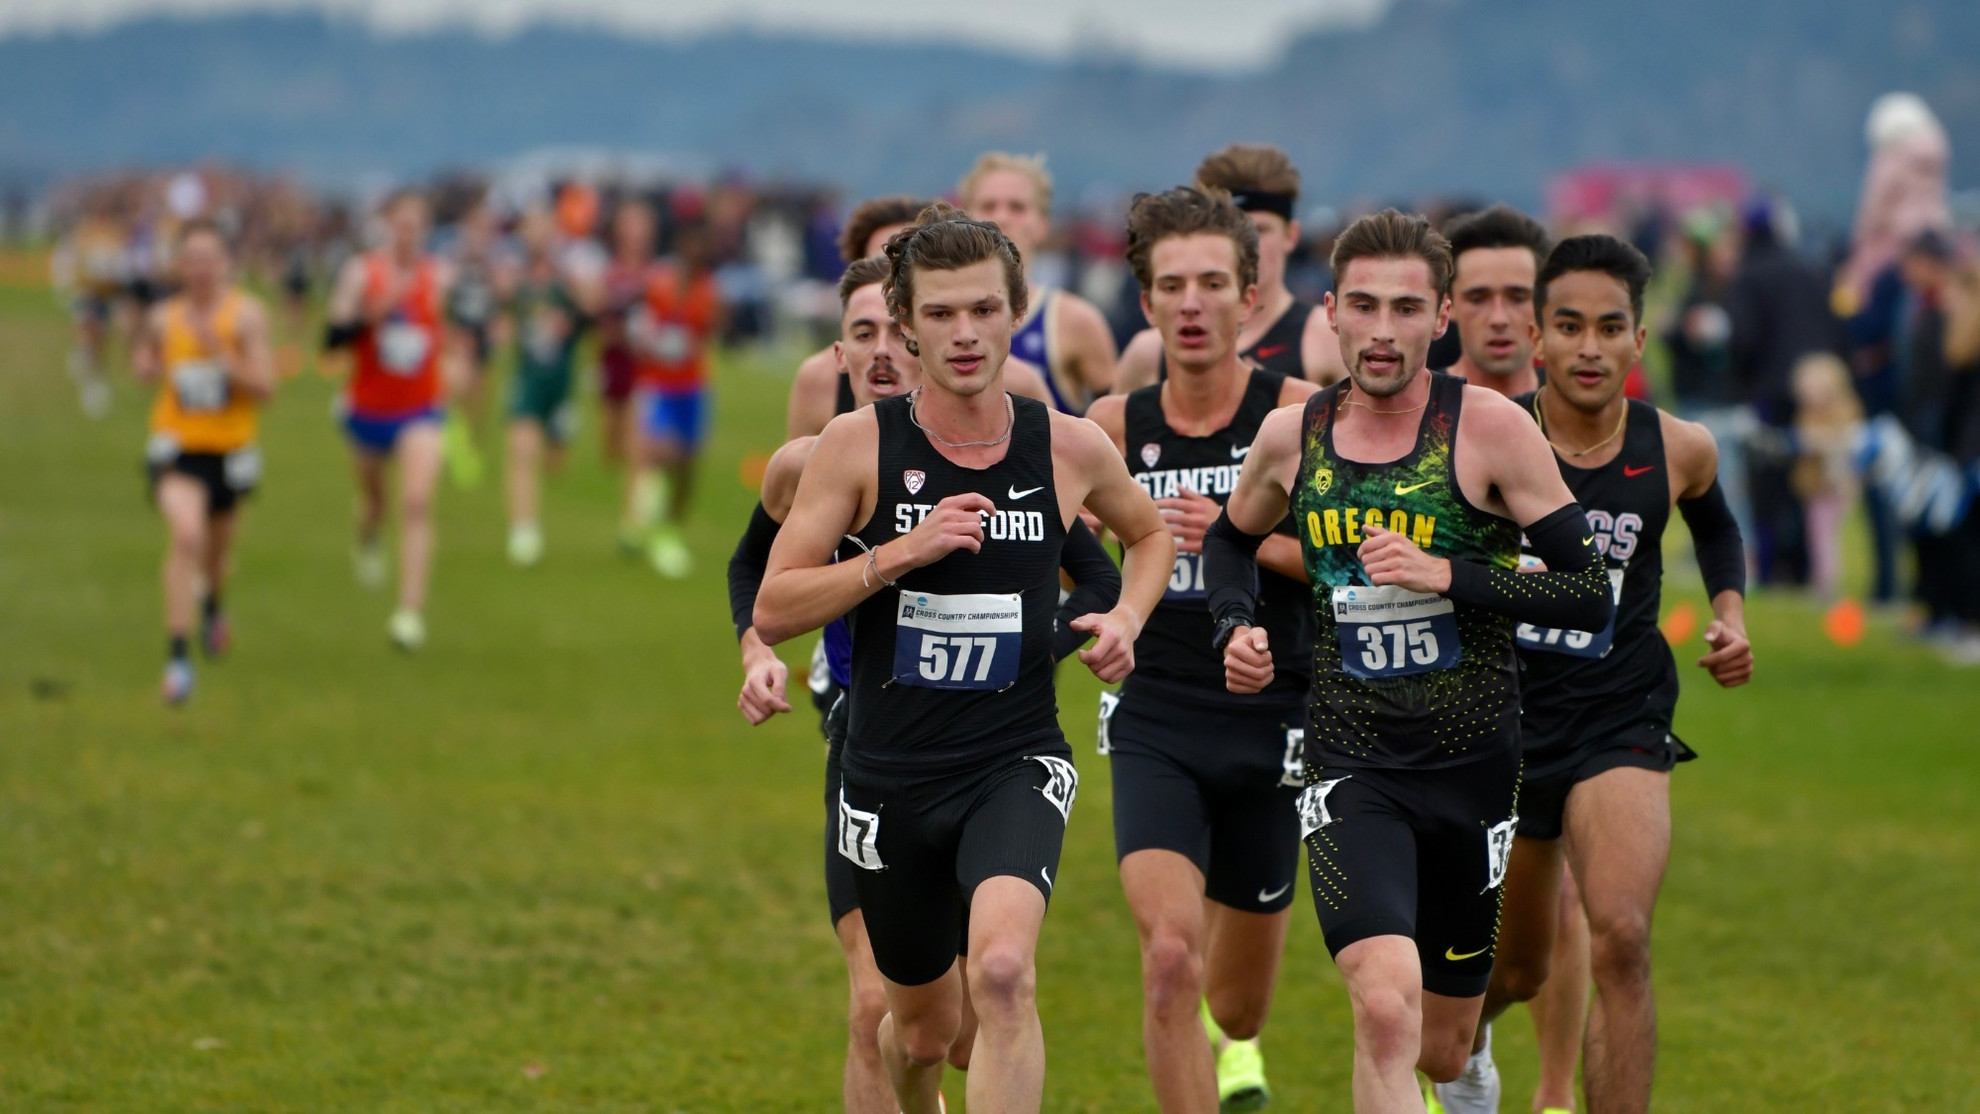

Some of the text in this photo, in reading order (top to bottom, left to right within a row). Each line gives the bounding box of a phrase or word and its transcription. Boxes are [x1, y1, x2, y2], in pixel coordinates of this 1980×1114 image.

[1307, 507, 1436, 548] OREGON
[915, 608, 1018, 621] CROSS COUNTRY CHAMPIONSHIPS
[1348, 603, 1367, 611] CROSS
[1368, 601, 1396, 611] COUNTRY
[919, 634, 997, 681] 577
[1357, 621, 1439, 670] 375
